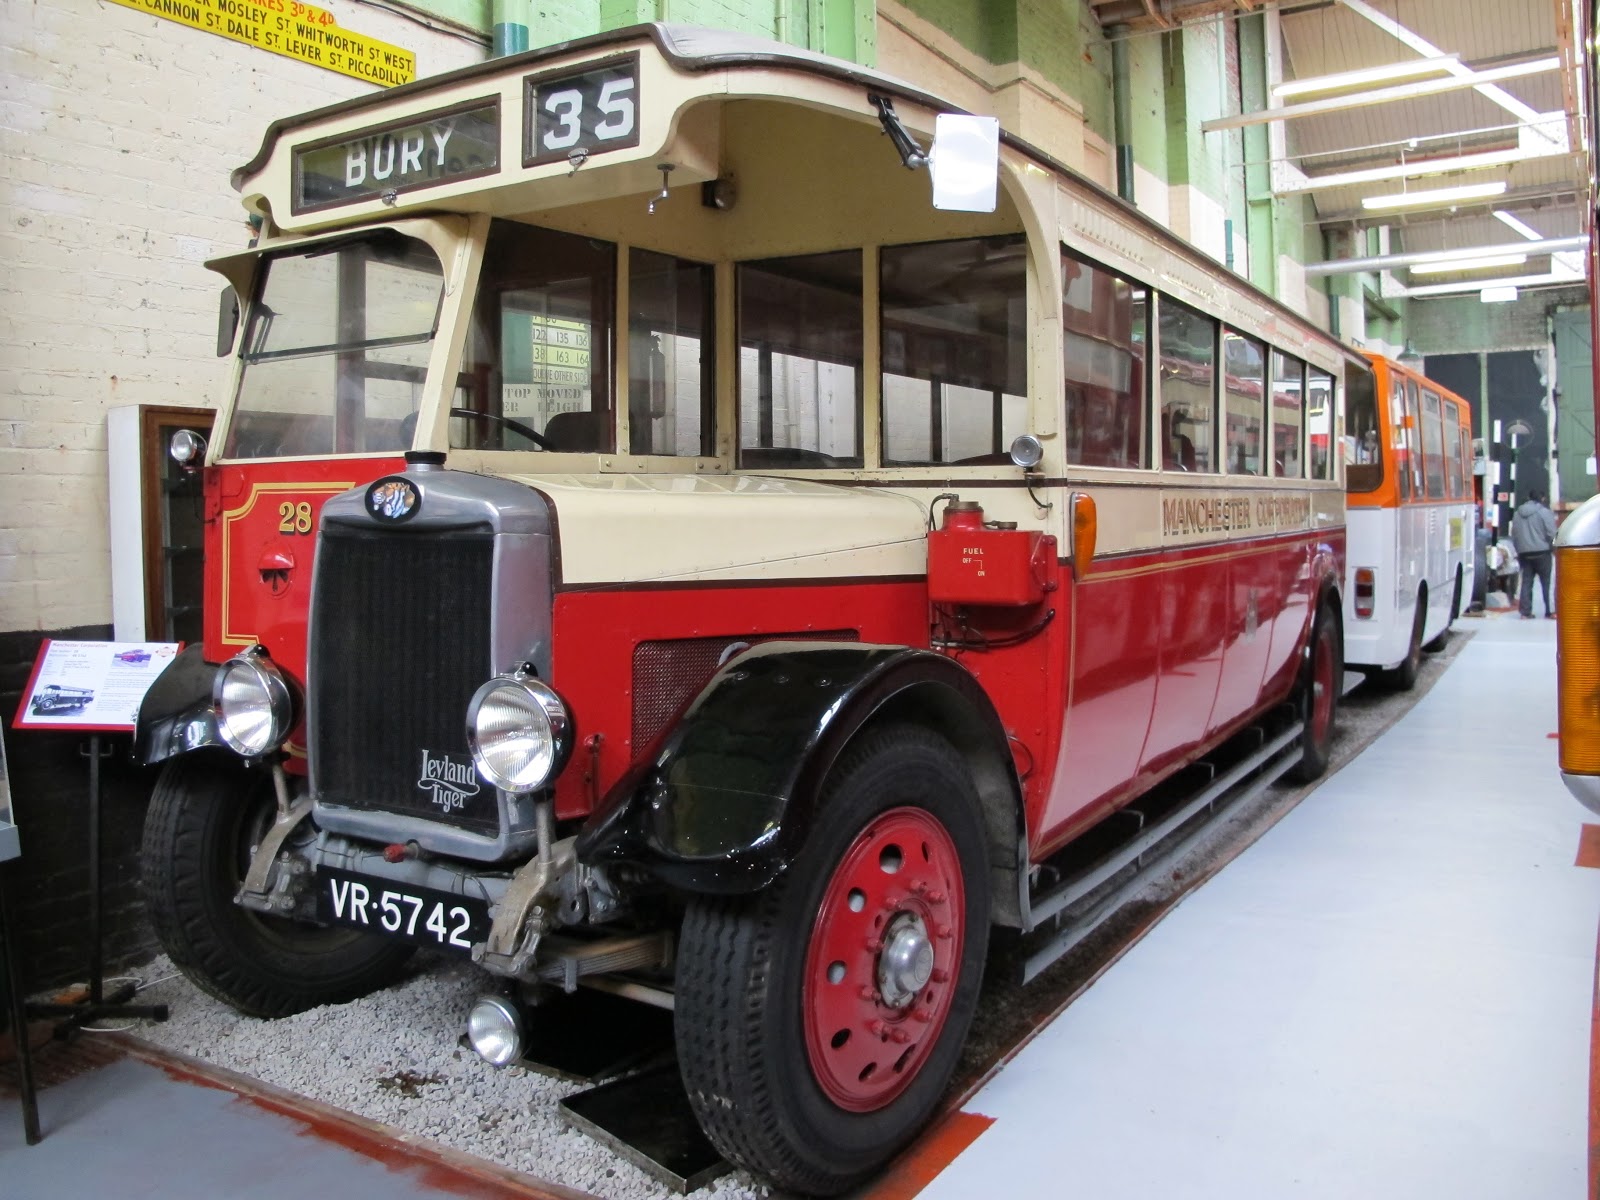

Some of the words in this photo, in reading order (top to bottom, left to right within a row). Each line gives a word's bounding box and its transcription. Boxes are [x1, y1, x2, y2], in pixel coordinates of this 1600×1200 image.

[219, 0, 267, 24] MOSLEY
[296, 22, 364, 57] WHITWORTH
[306, 10, 315, 23] &
[145, 0, 199, 23] CANNON
[228, 19, 259, 41] DALE
[286, 38, 321, 61] LEVER
[348, 57, 408, 85] PICCADILLY
[543, 77, 635, 150] 35
[345, 121, 456, 188] BURY
[556, 331, 569, 345] 135
[575, 334, 588, 347] 136
[556, 350, 569, 364] 163
[554, 370, 575, 382] OTHER
[537, 388, 582, 399] MOVED
[279, 501, 313, 535] 28
[1163, 497, 1251, 536] MANCHESTER
[963, 547, 984, 555] FUEL
[420, 749, 477, 786] Leyland
[432, 782, 467, 813] Tiger
